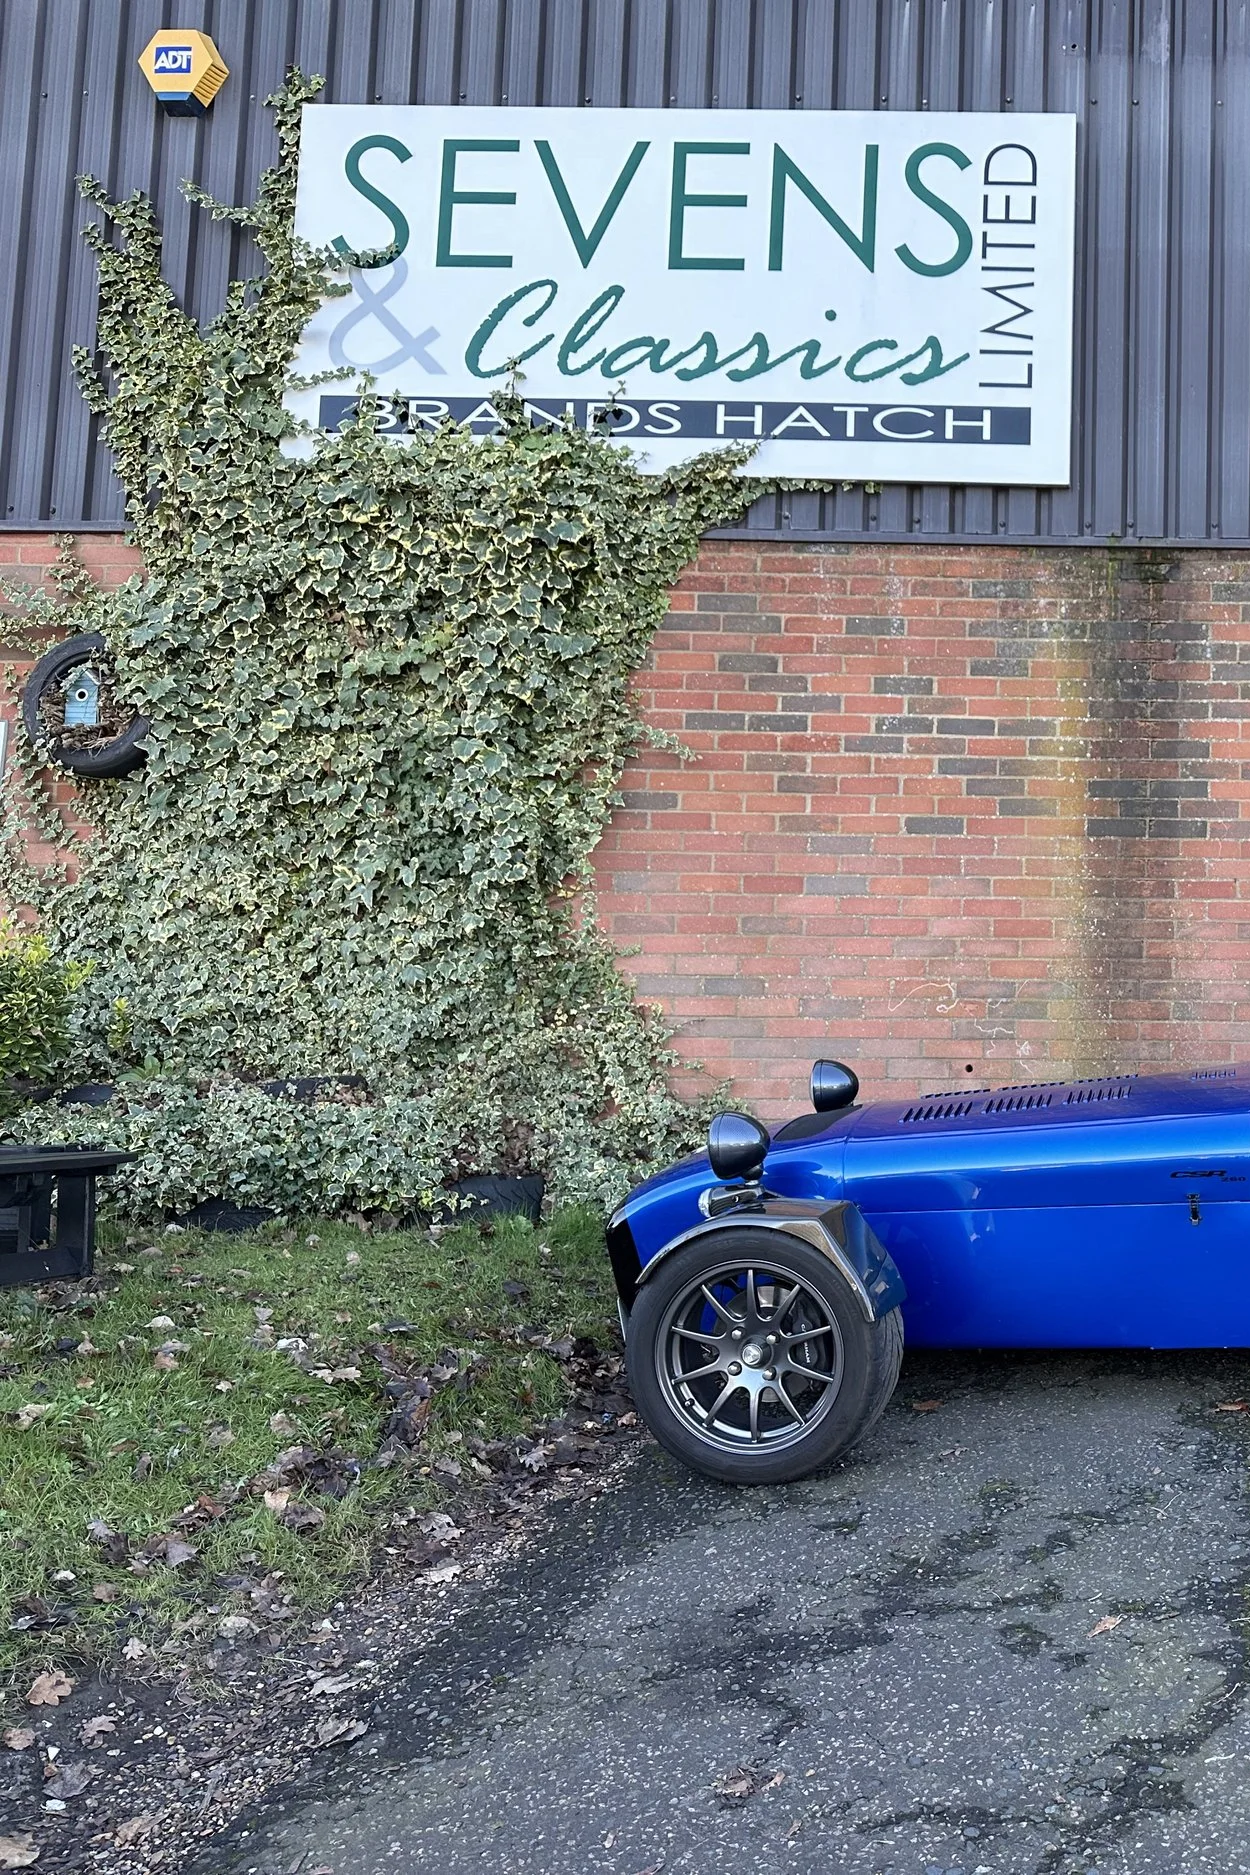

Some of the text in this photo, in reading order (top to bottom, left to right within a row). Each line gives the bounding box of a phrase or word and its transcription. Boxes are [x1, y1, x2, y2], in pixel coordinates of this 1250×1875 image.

[154, 50, 192, 70] ADT
[331, 134, 973, 277] SEVENS
[979, 143, 1038, 389] LIMITED
[328, 261, 971, 386] & Classics
[362, 399, 991, 441] BRANDS HATCH
[1170, 1169, 1227, 1179] CSR
